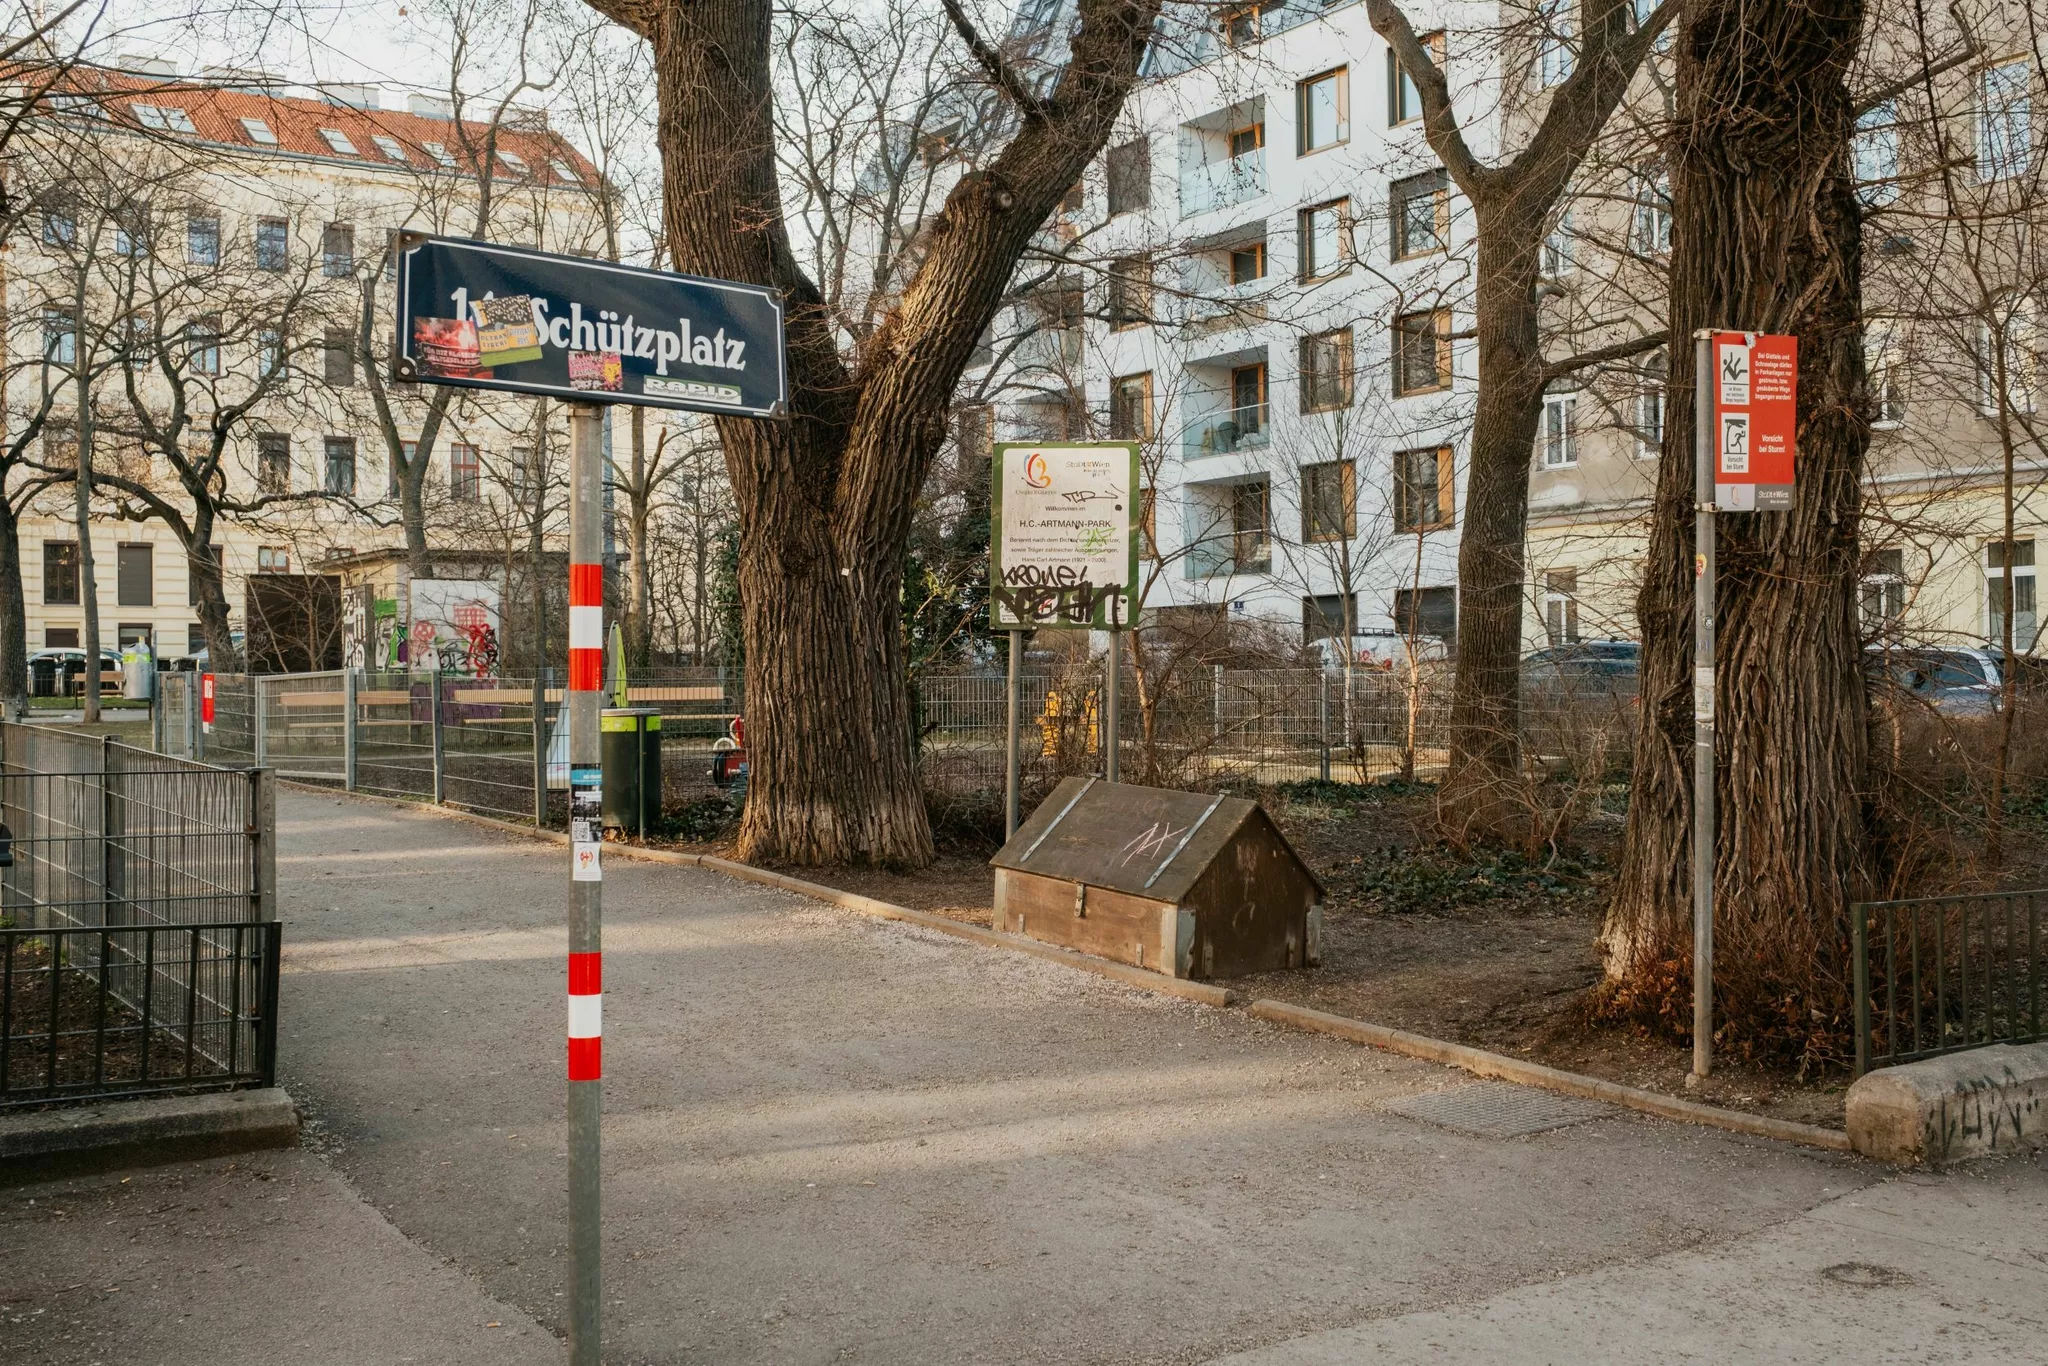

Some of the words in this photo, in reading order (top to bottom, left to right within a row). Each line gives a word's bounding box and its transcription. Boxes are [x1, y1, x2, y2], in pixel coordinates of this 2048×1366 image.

[534, 297, 746, 376] Schützplatz
[646, 378, 739, 397] RAPID
[1762, 434, 1784, 442] Vorsicht
[1758, 445, 1767, 453] bei
[1768, 445, 1786, 453] Sturm!
[1019, 519, 1112, 528] H.C.-ARTMANN-PARK
